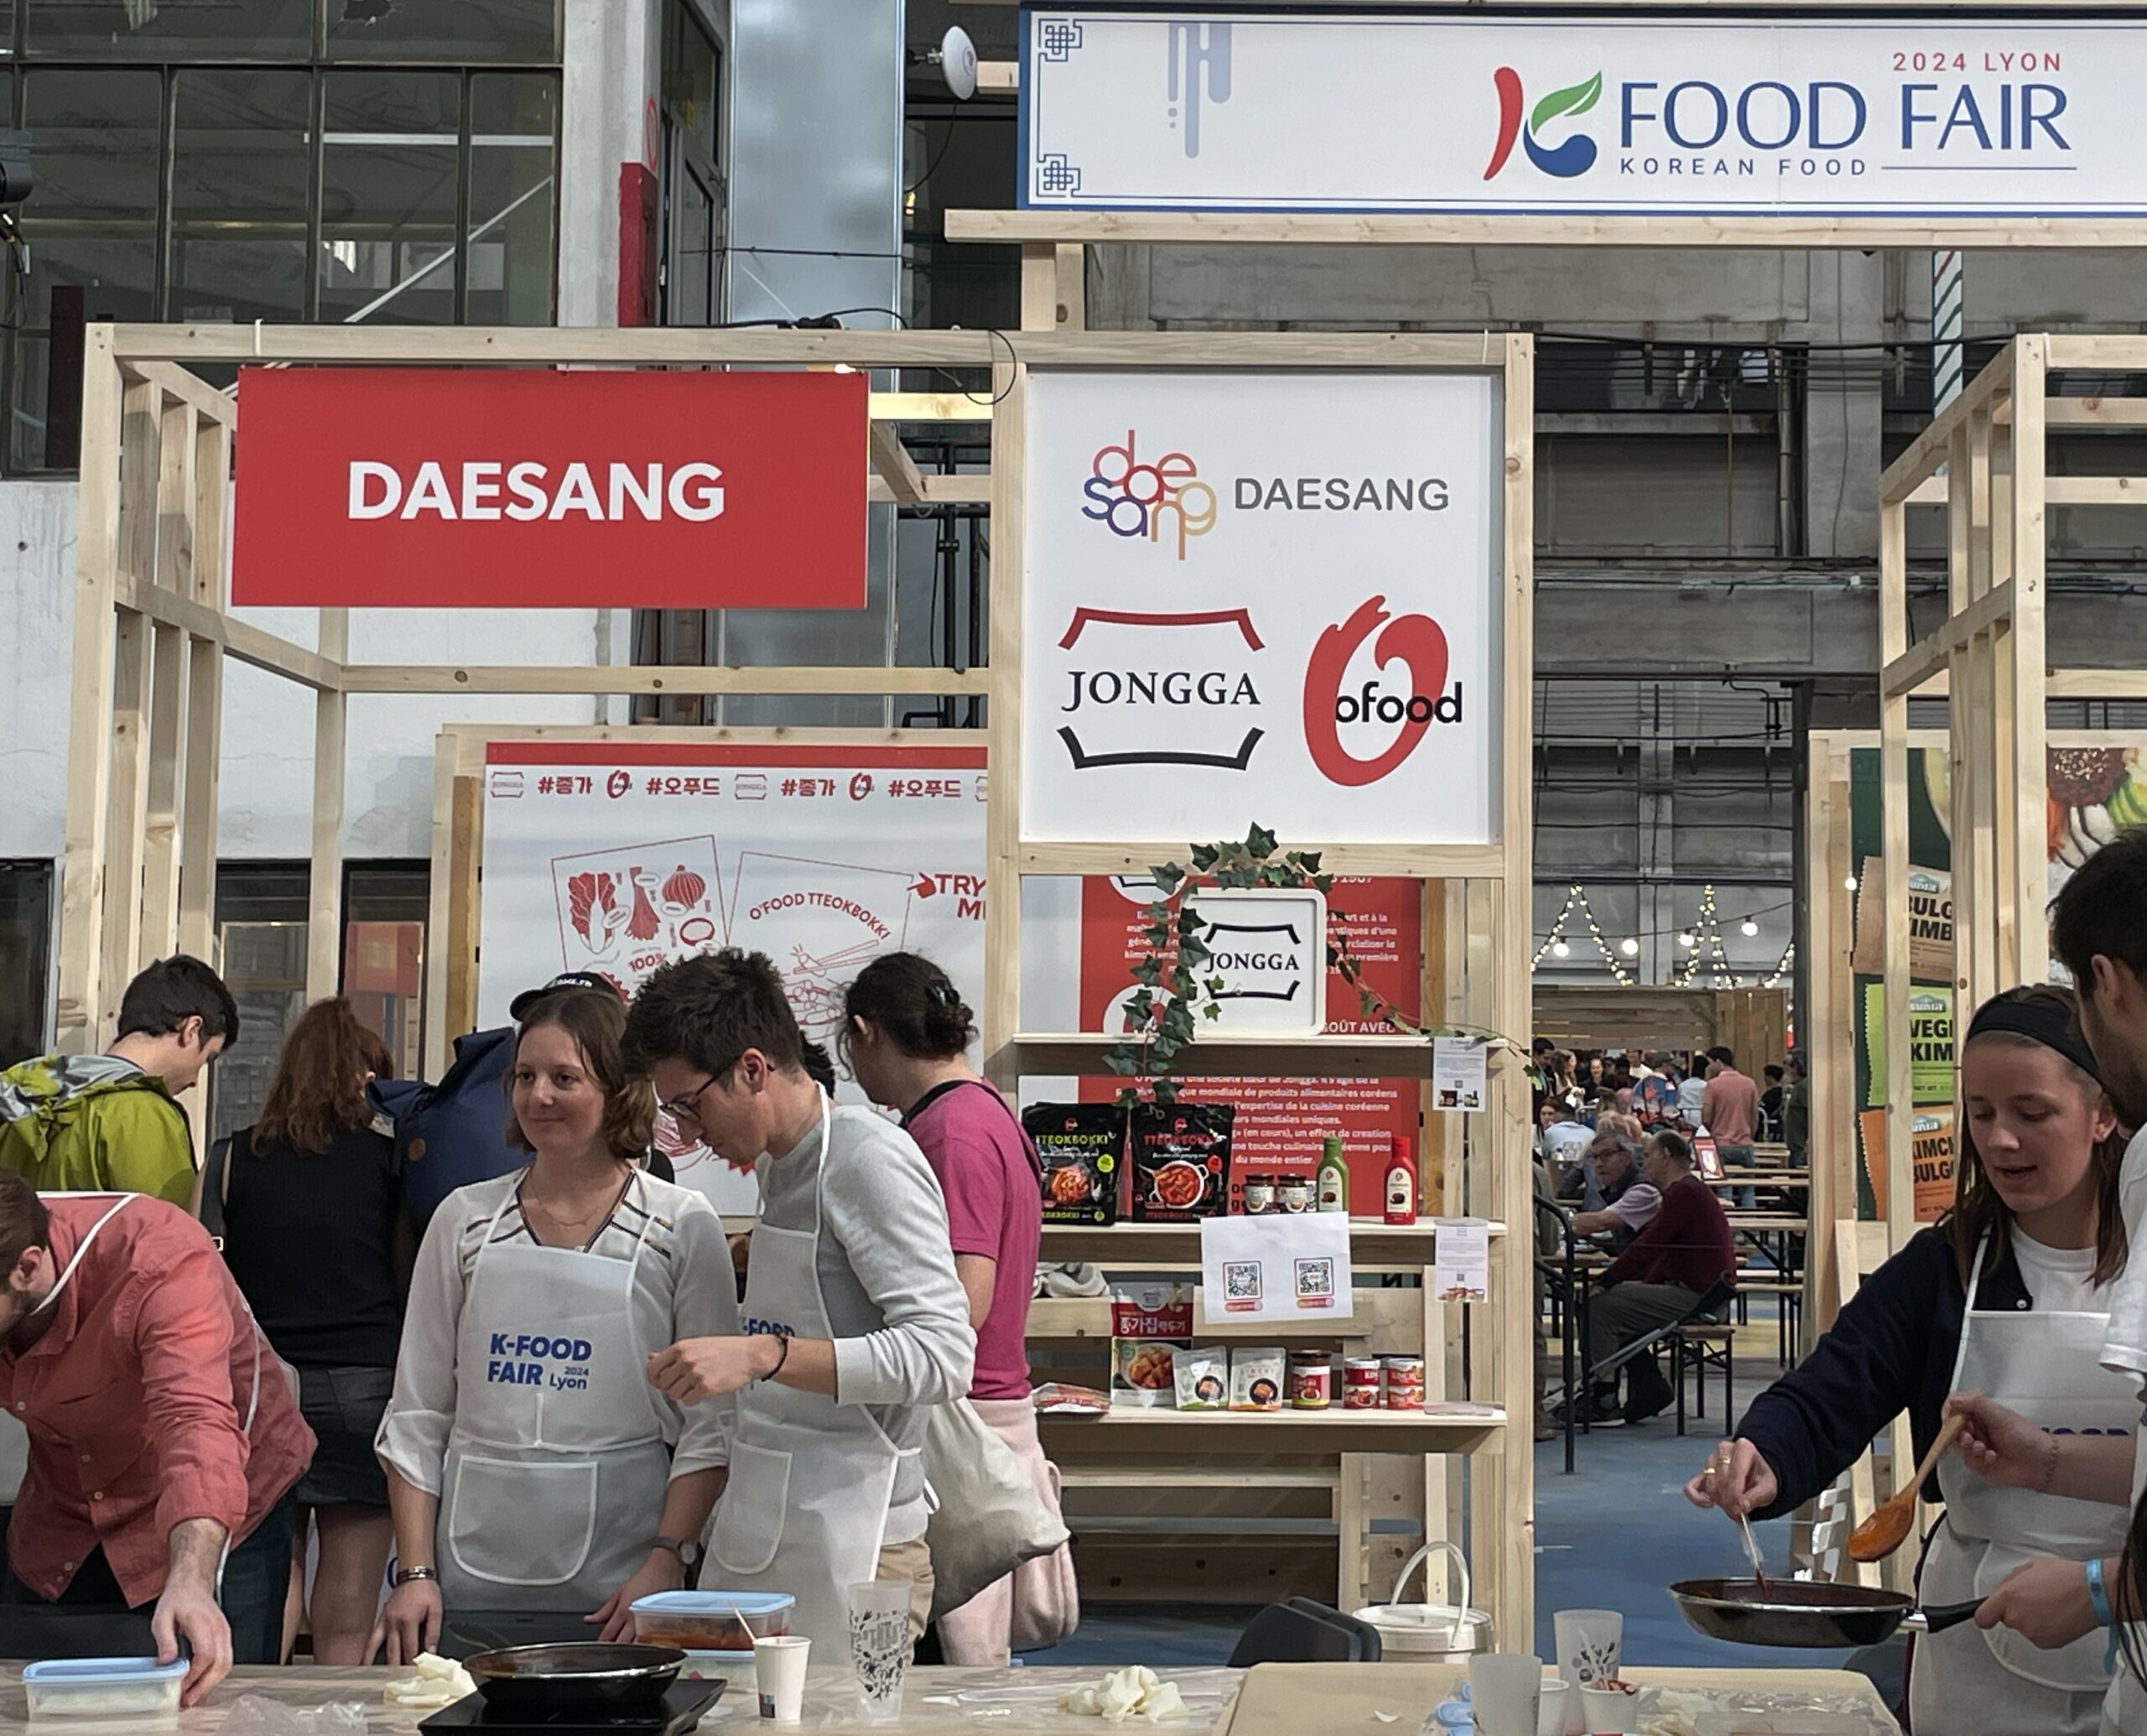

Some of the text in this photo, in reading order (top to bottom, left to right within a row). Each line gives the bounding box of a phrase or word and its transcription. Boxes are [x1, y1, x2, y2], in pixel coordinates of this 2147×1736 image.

[1893, 52, 2062, 72] 2024 LYON
[1620, 81, 1867, 150] FOOD
[1900, 84, 2072, 151] FAIR
[1619, 159, 1867, 176] KOREAN FOOD
[347, 461, 725, 522] DAESANG
[1235, 477, 1449, 512] DAESANG
[1060, 671, 1262, 712] JONGGA
[1334, 681, 1463, 724] ofood
[538, 777, 593, 794] #종가
[646, 777, 720, 796] #오푸드
[781, 779, 836, 797] #종가
[888, 780, 962, 798] #오푸드
[934, 873, 987, 897] TRY
[808, 892, 891, 940] TTEOKBOKKI
[957, 897, 986, 921] M
[1203, 953, 1301, 974] JONGGA
[490, 1333, 592, 1361] K-FOOD
[487, 1360, 587, 1391] FAIR Lyon
[564, 1365, 589, 1376] 2024
